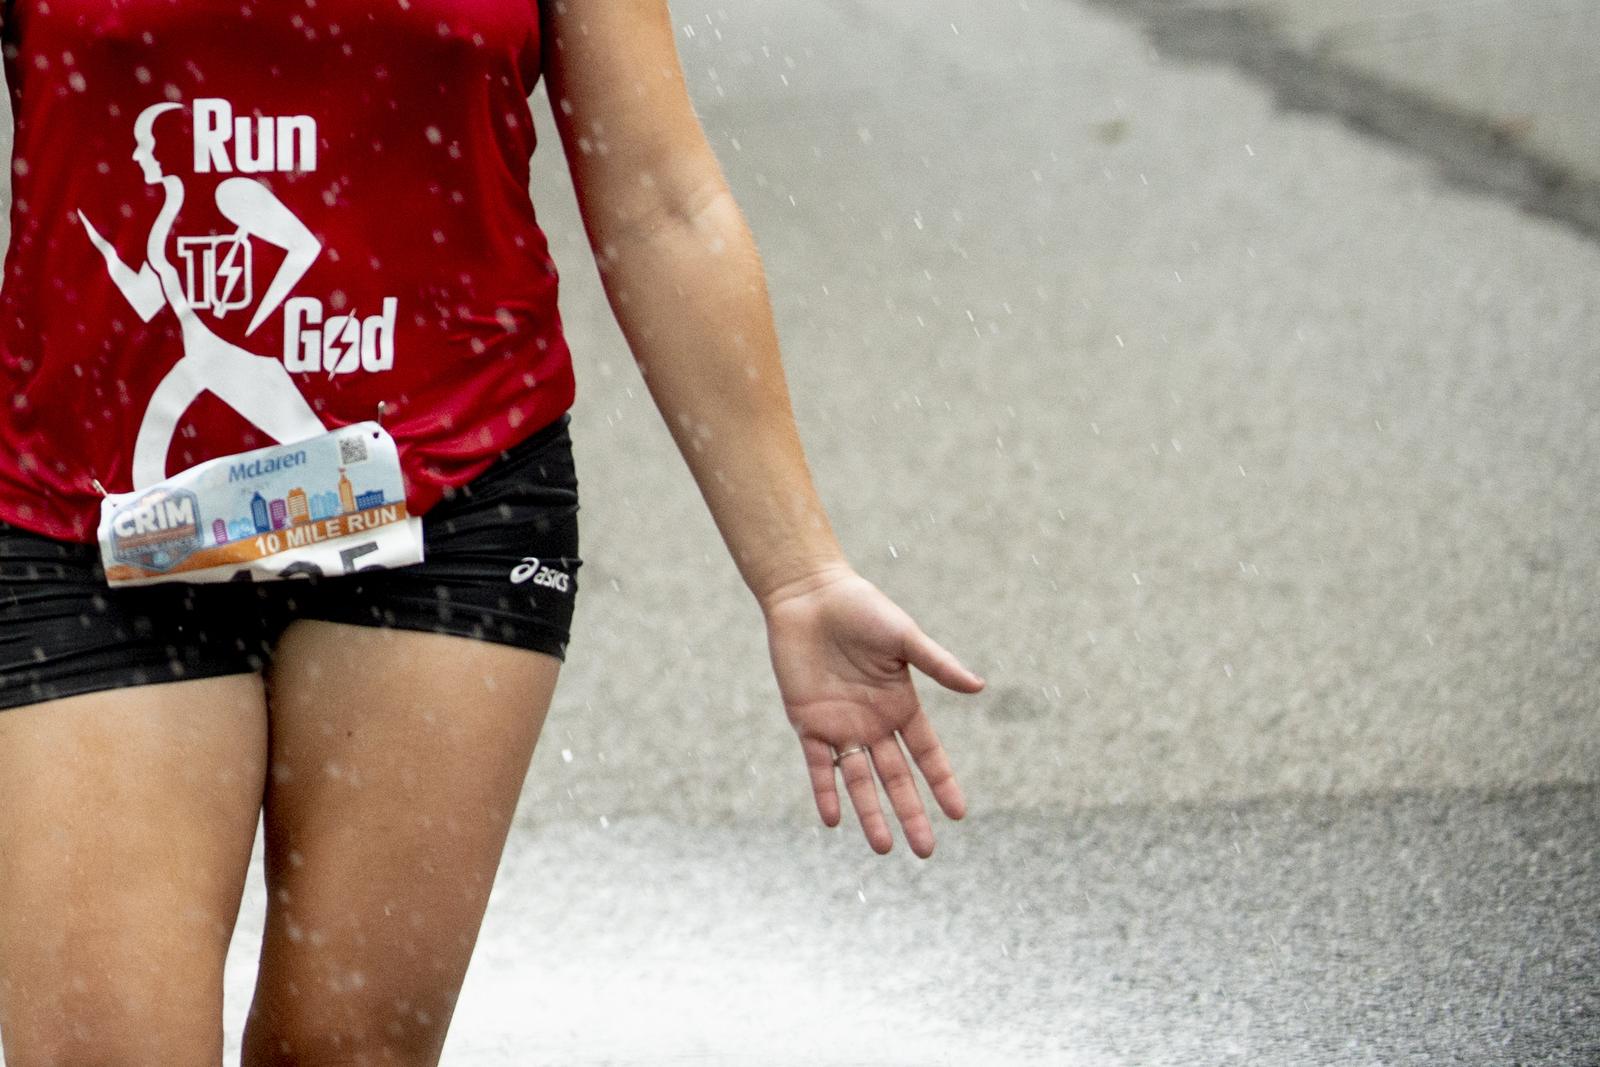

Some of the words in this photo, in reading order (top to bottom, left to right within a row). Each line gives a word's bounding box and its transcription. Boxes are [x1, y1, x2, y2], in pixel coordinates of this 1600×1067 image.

[193, 98, 317, 173] Run
[284, 296, 398, 381] God
[228, 450, 307, 483] McLaren
[113, 497, 195, 537] CRIM
[255, 534, 280, 556] 10
[286, 517, 341, 548] MILE
[346, 505, 398, 534] RUN
